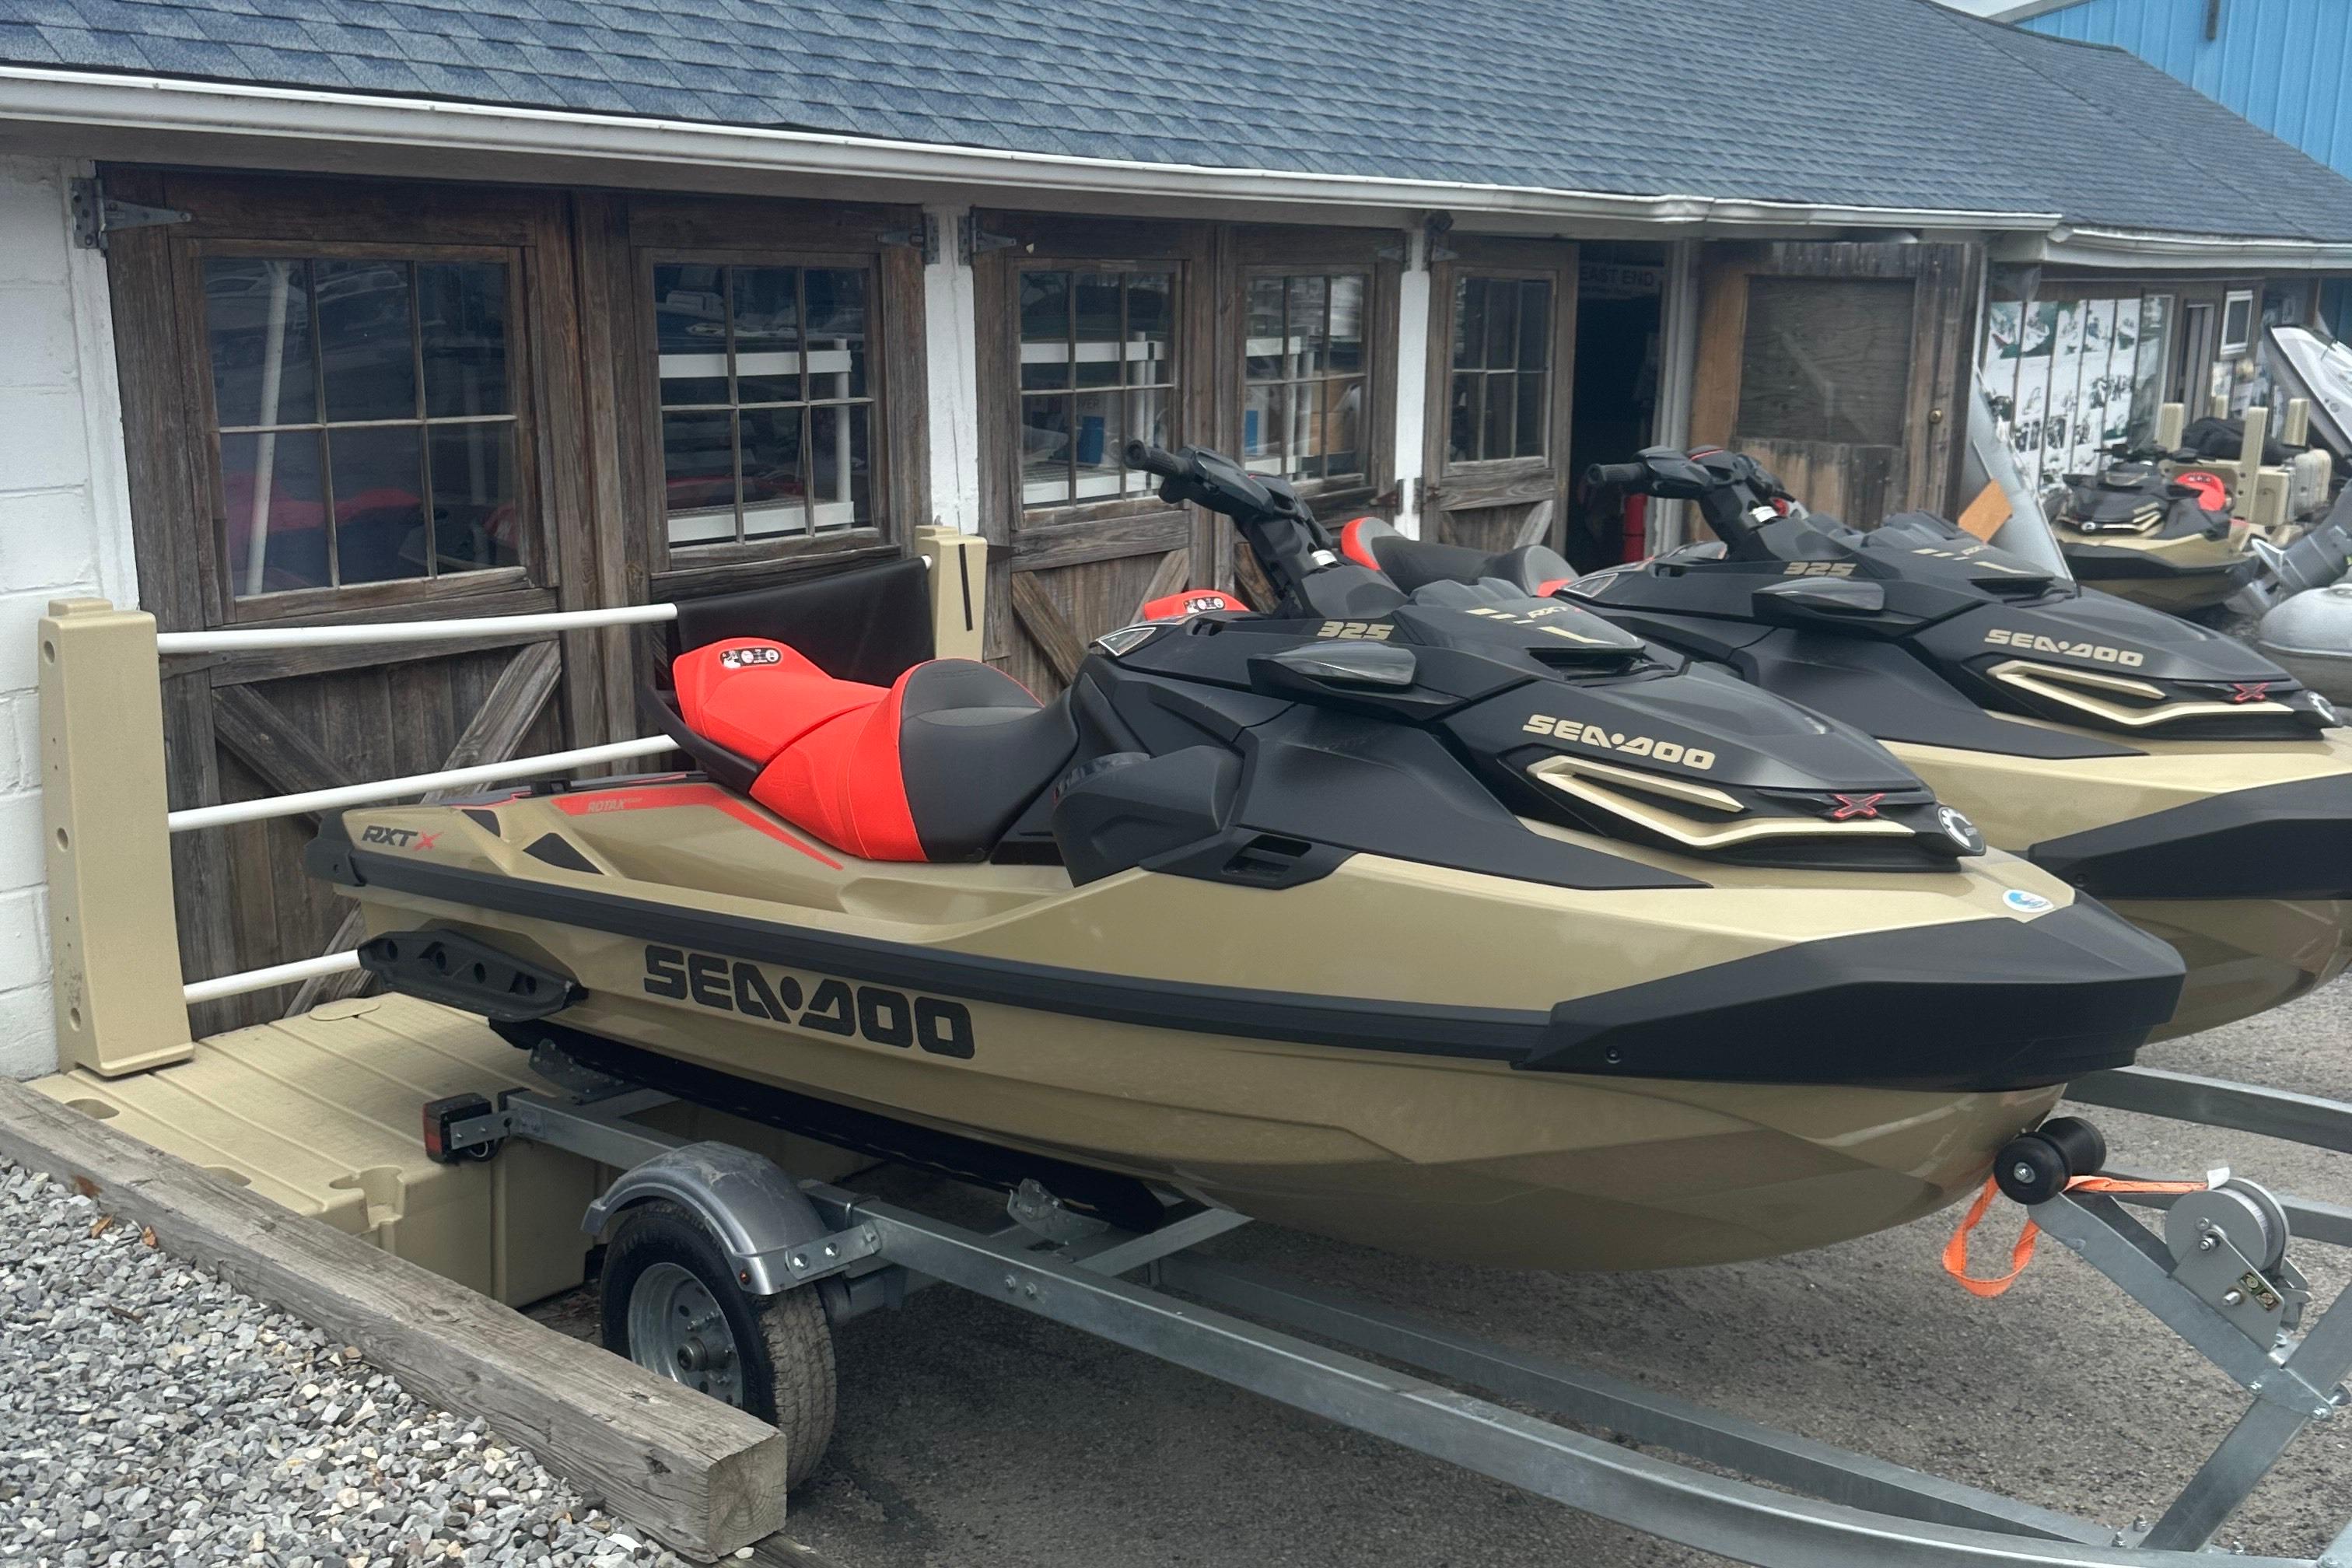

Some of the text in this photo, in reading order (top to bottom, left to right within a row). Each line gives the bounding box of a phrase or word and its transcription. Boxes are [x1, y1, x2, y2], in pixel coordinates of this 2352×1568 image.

[1622, 269, 1654, 287] END
[1783, 562, 1857, 577] 325
[1317, 621, 1395, 641] 325
